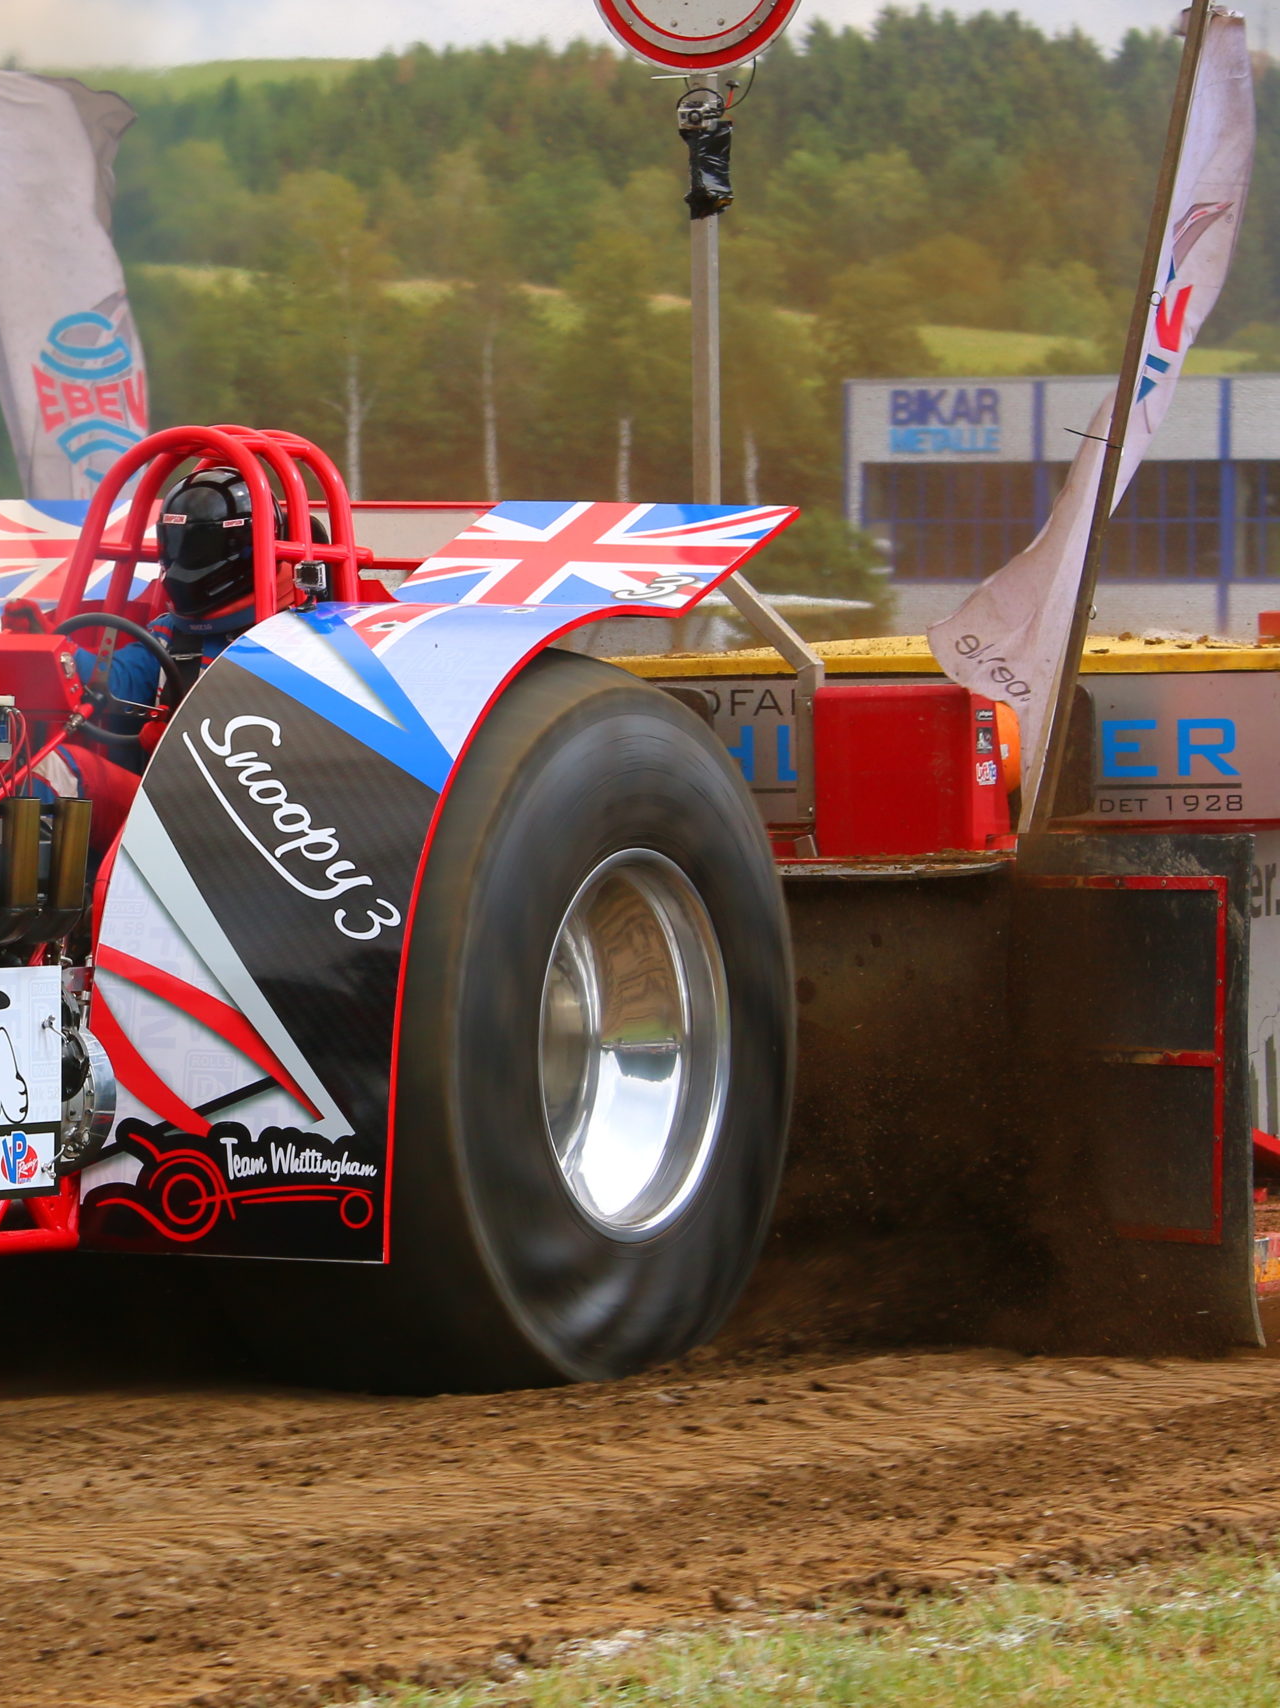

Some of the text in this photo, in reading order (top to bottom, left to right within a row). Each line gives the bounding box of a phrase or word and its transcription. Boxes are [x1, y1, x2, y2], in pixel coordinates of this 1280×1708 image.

[890, 388, 1000, 425] BIKAR
[889, 427, 1001, 453] METALLE
[610, 575, 699, 600] 3
[1165, 794, 1243, 812] 1928
[183, 715, 401, 940] Snoopy 3
[1, 1132, 27, 1184] VP
[219, 1137, 378, 1182] Team Whittingham
